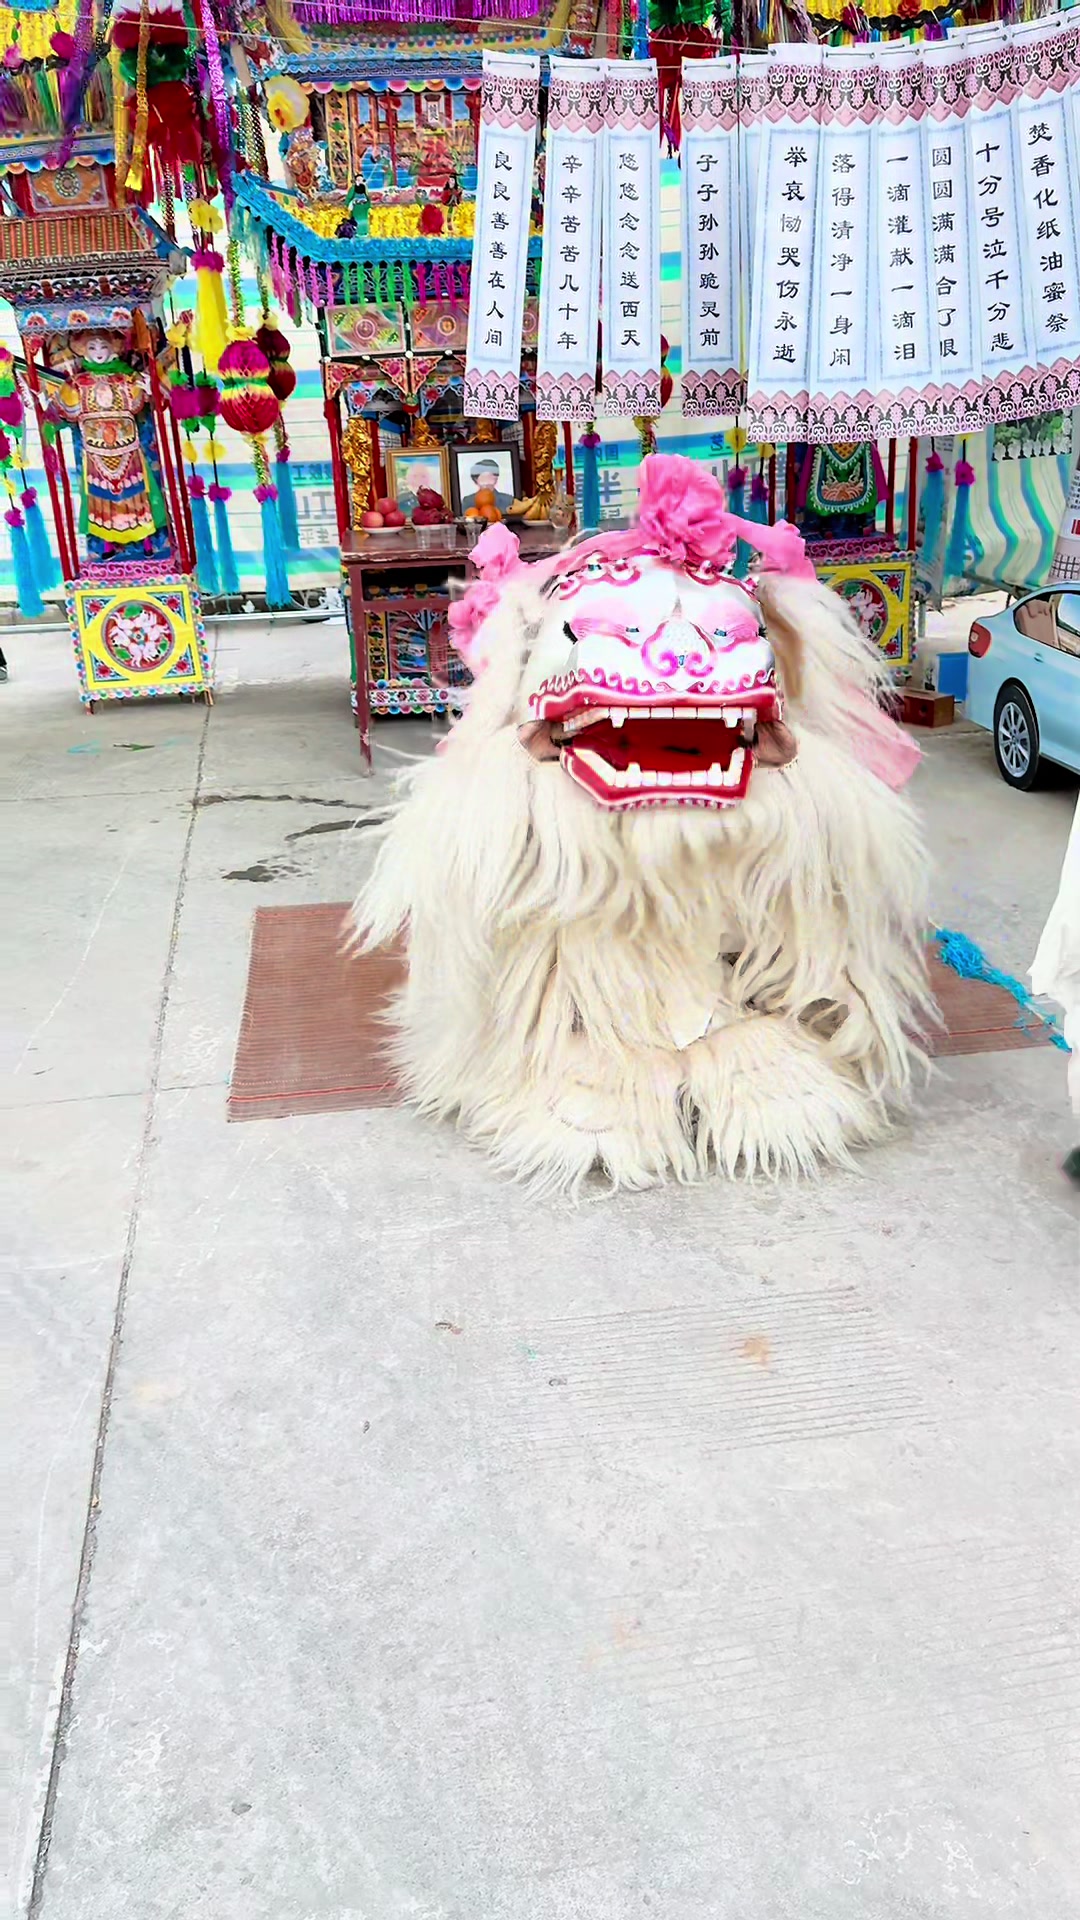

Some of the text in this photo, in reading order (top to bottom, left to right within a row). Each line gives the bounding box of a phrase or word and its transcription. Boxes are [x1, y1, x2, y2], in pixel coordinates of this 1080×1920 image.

[485, 151, 512, 347] 良良善善在人间
[557, 155, 582, 349] 辛辛苦苦几十年
[618, 153, 640, 347] 悠悠念念送西天
[696, 154, 720, 347] 子子孙孙跪灵前
[772, 146, 808, 364] 举哀恸哭伤永逝
[829, 153, 856, 367] 落得清净一身闲
[886, 155, 916, 361] 一滴灌献一滴泪
[976, 142, 1014, 352] 十分号泣千分悲
[1027, 122, 1069, 333] 焚香化纸油蜜祭
